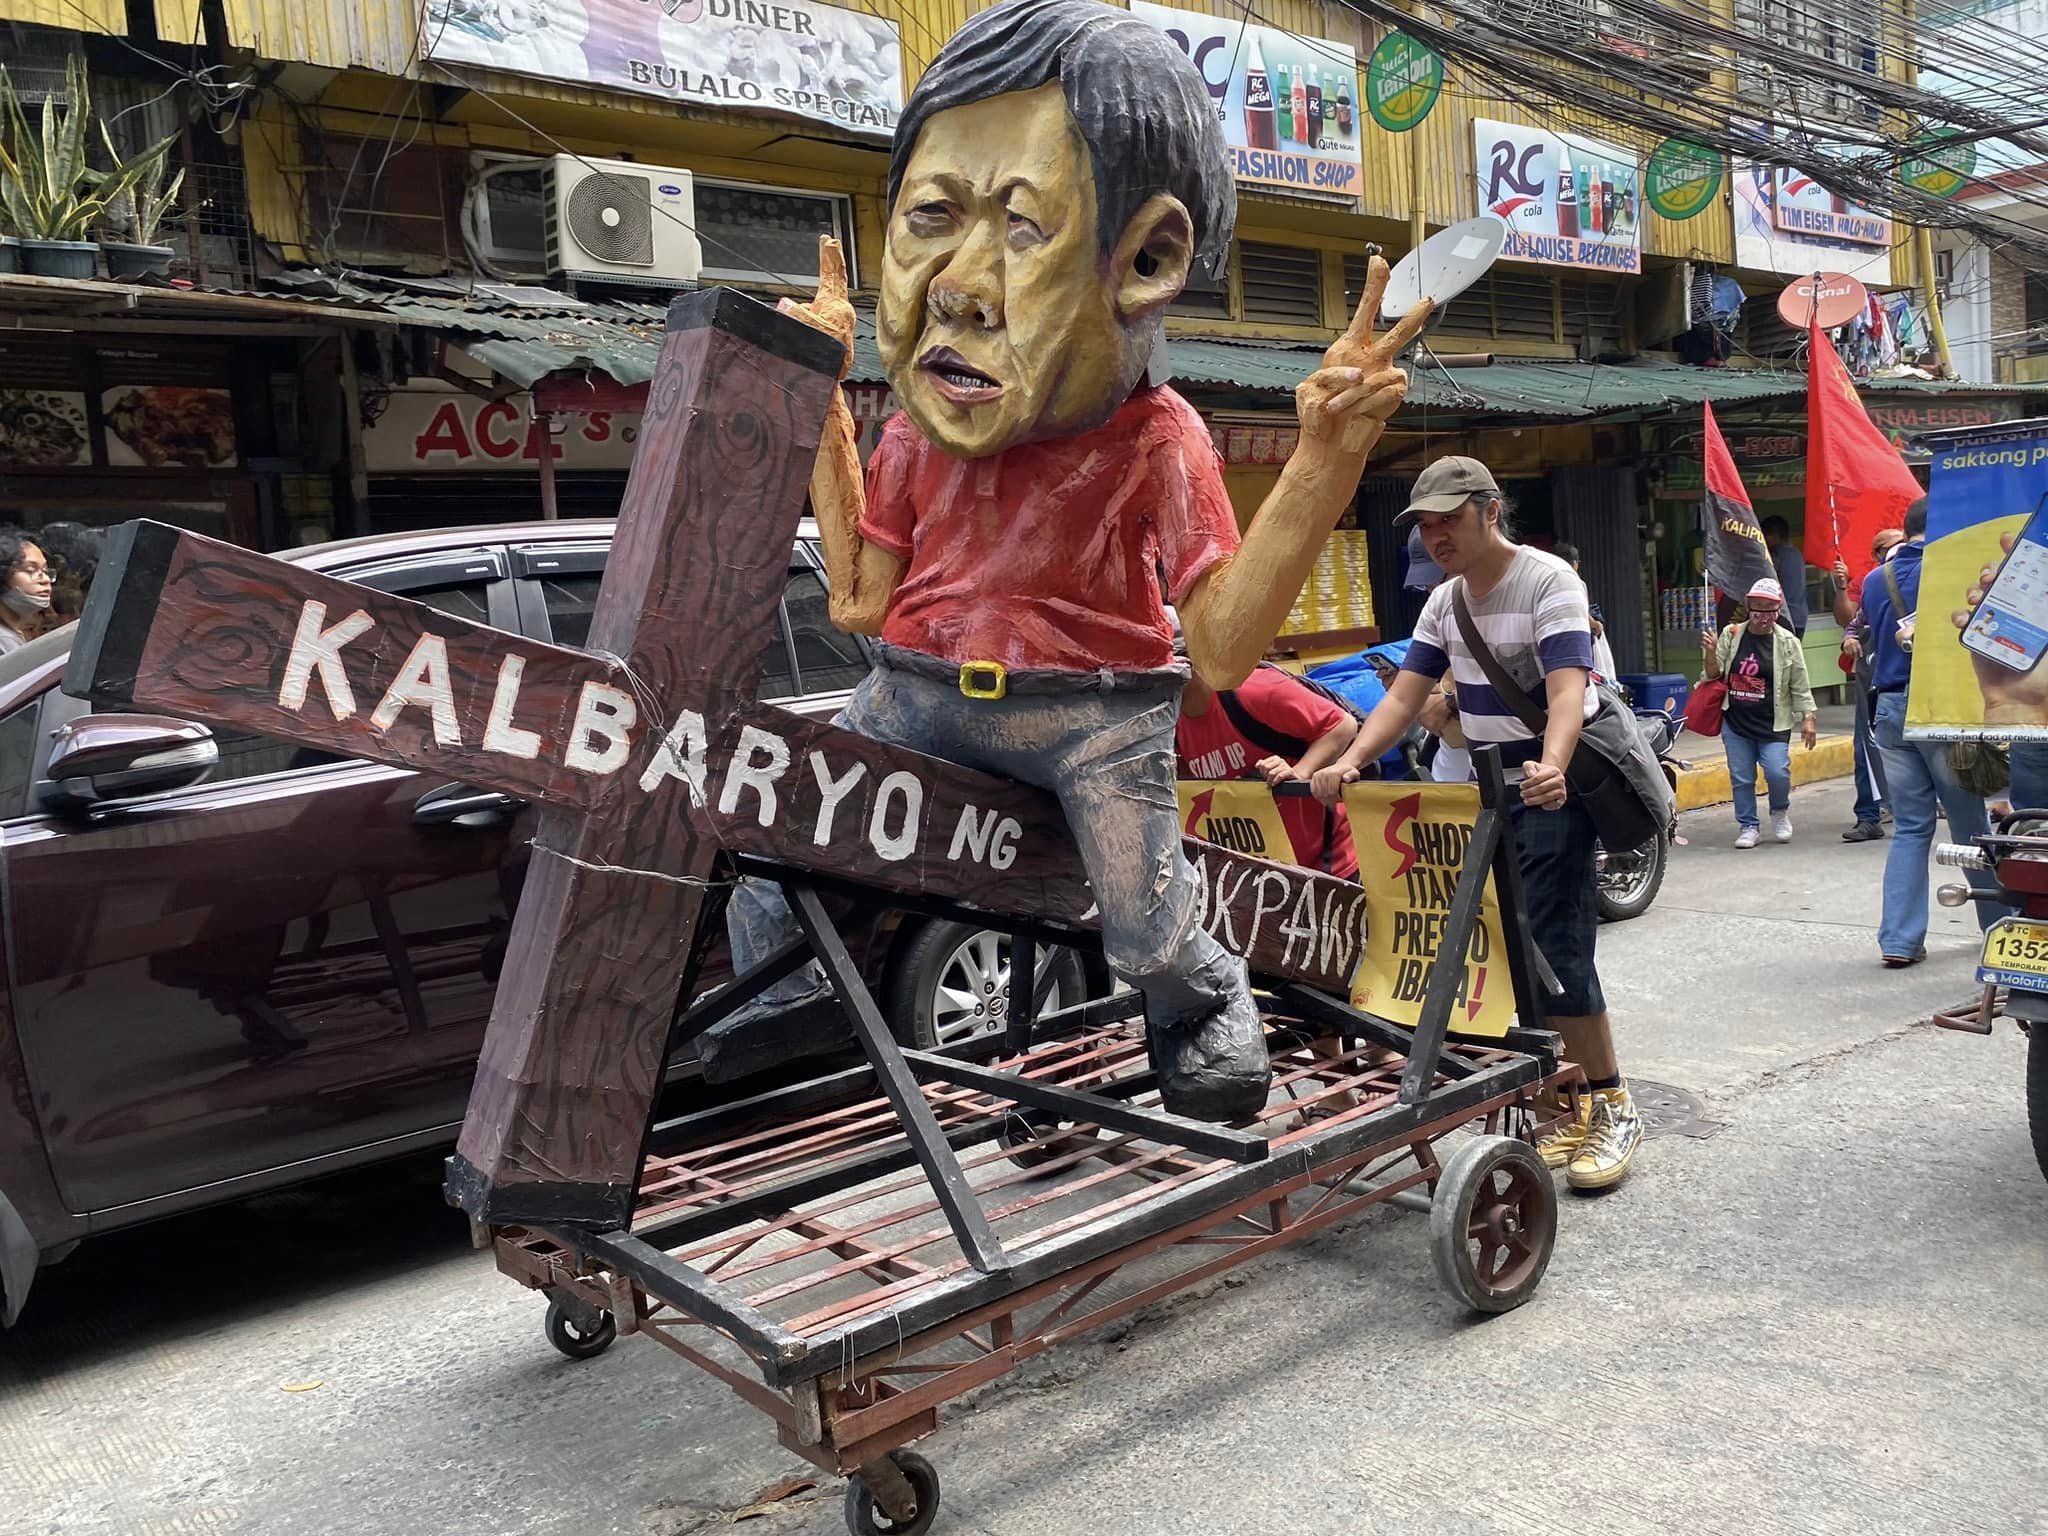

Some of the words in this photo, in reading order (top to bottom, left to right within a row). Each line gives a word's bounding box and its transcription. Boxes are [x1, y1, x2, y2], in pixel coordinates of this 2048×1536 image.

[708, 0, 816, 37] DINER
[629, 60, 762, 101] BULALO
[774, 87, 898, 129] SPECIAL
[1247, 91, 1270, 105] MEGA
[1313, 161, 1355, 189] SHOP
[1488, 139, 1545, 207] RC
[1808, 184, 1822, 196] cola
[1524, 203, 1543, 217] cola
[1781, 206, 1802, 228] TIM
[1804, 211, 1835, 232] EISEN
[1837, 217, 1884, 241] HALO-HALO
[1578, 242, 1638, 270] BEVERAGES
[1943, 448, 2027, 470] saktong
[2032, 446, 2048, 466] p
[278, 600, 924, 862] KALBARYO
[947, 803, 1023, 871] NG
[1188, 749, 1228, 779] STAND
[1224, 742, 1247, 771] UP
[2017, 926, 2030, 935] TC
[2001, 960, 2048, 972] TEMPORARY
